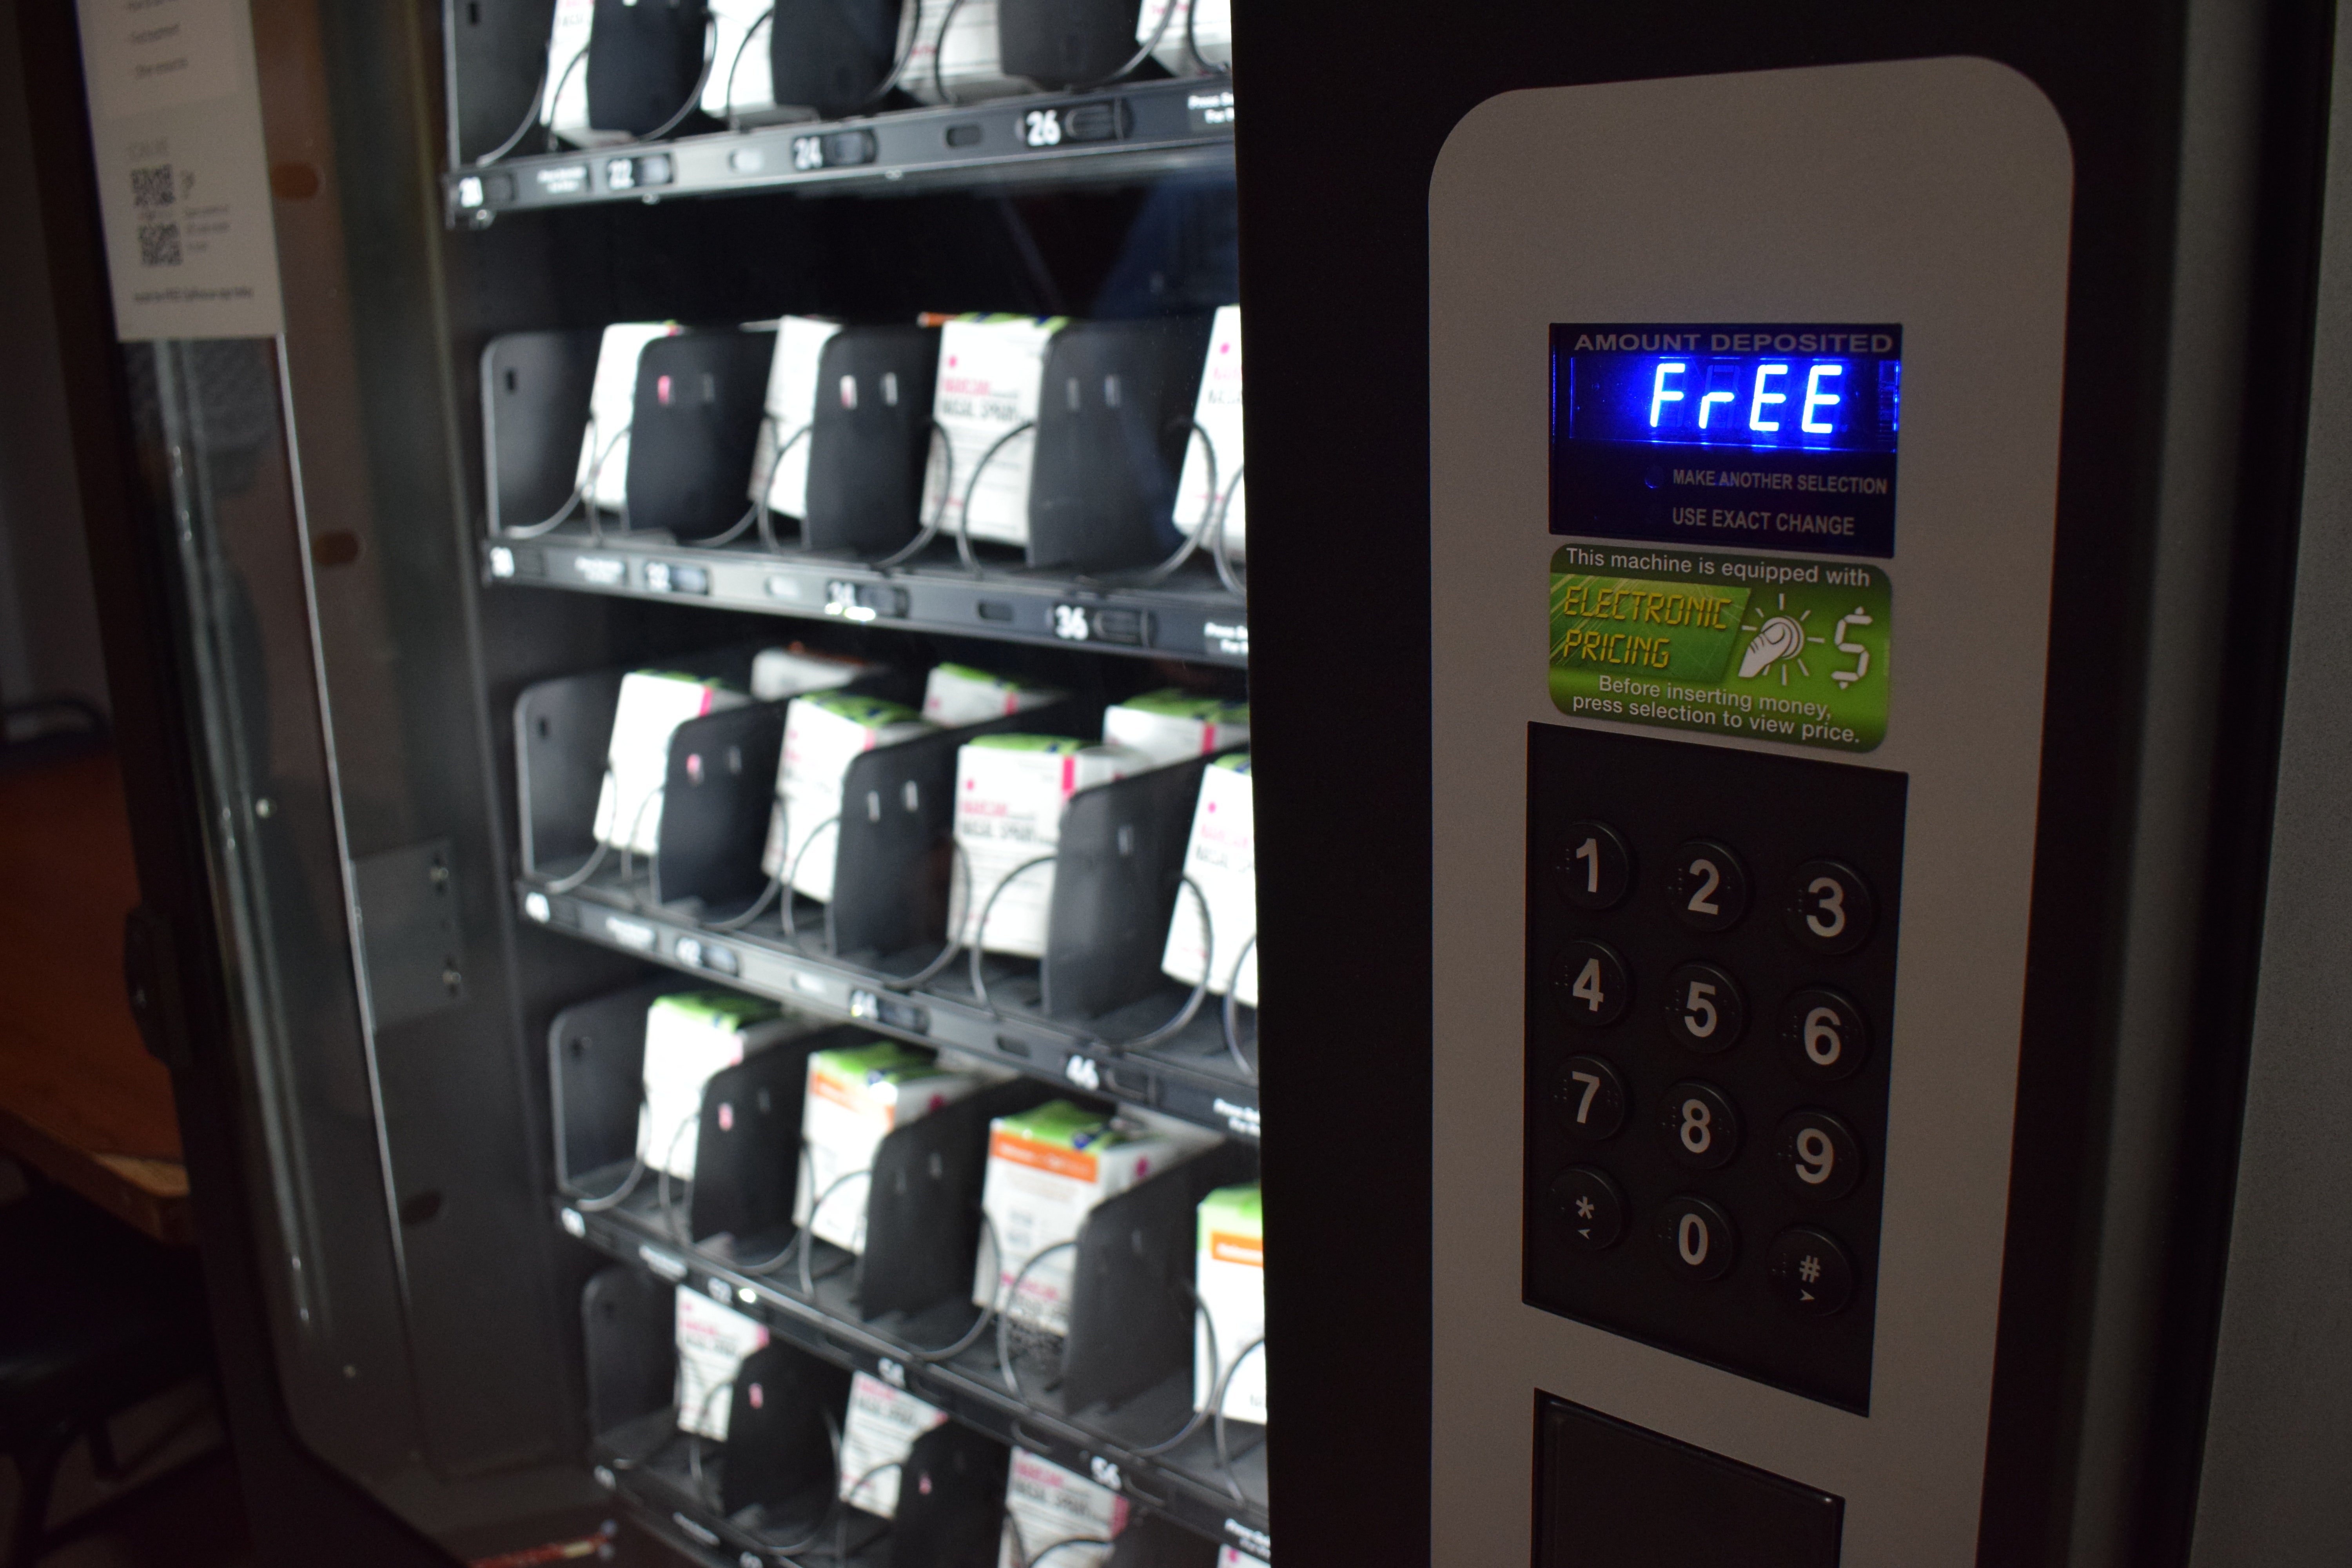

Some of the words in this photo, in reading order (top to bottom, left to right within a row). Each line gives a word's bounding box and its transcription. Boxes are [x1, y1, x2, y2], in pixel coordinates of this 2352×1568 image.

[794, 136, 823, 169] 24
[1026, 111, 1061, 146] 26
[1574, 334, 1700, 350] AMOUNT
[1711, 334, 1893, 352] DEPOSITED
[1673, 470, 1715, 486] MAKE
[1719, 472, 1792, 490] ANOTHER
[1798, 474, 1887, 494] SELECTION
[1673, 508, 1706, 526] USE
[1712, 509, 1771, 530] EXACT
[1776, 513, 1854, 535] CHANGE
[1566, 548, 1604, 566] This
[1612, 553, 1691, 573] machine
[1699, 559, 1714, 574] is
[1722, 562, 1818, 584] equipped
[1826, 567, 1870, 586] with
[1055, 605, 1089, 641] 36
[1564, 586, 1732, 630] ELECTRONIC
[1564, 629, 1670, 668] PRICING
[1831, 606, 1873, 690] $
[1573, 695, 1622, 717] press
[1629, 699, 1716, 725] selection
[1723, 713, 1742, 729] to
[1750, 715, 1795, 735] view
[1802, 723, 1860, 743] price.
[1599, 675, 1660, 698] Before
[1667, 682, 1752, 711] inserting
[1759, 695, 1832, 720] money,
[1576, 838, 1598, 893] 1
[1688, 859, 1719, 915] 2
[1806, 877, 1845, 937] 3
[1573, 958, 1604, 1012] 4
[1684, 981, 1717, 1037] 5
[1804, 1007, 1841, 1065] 6
[1572, 1071, 1600, 1124] 7
[1681, 1099, 1711, 1153] 8
[1795, 1128, 1834, 1184] 9
[1679, 1213, 1708, 1265] 0
[1799, 1255, 1820, 1283] #
